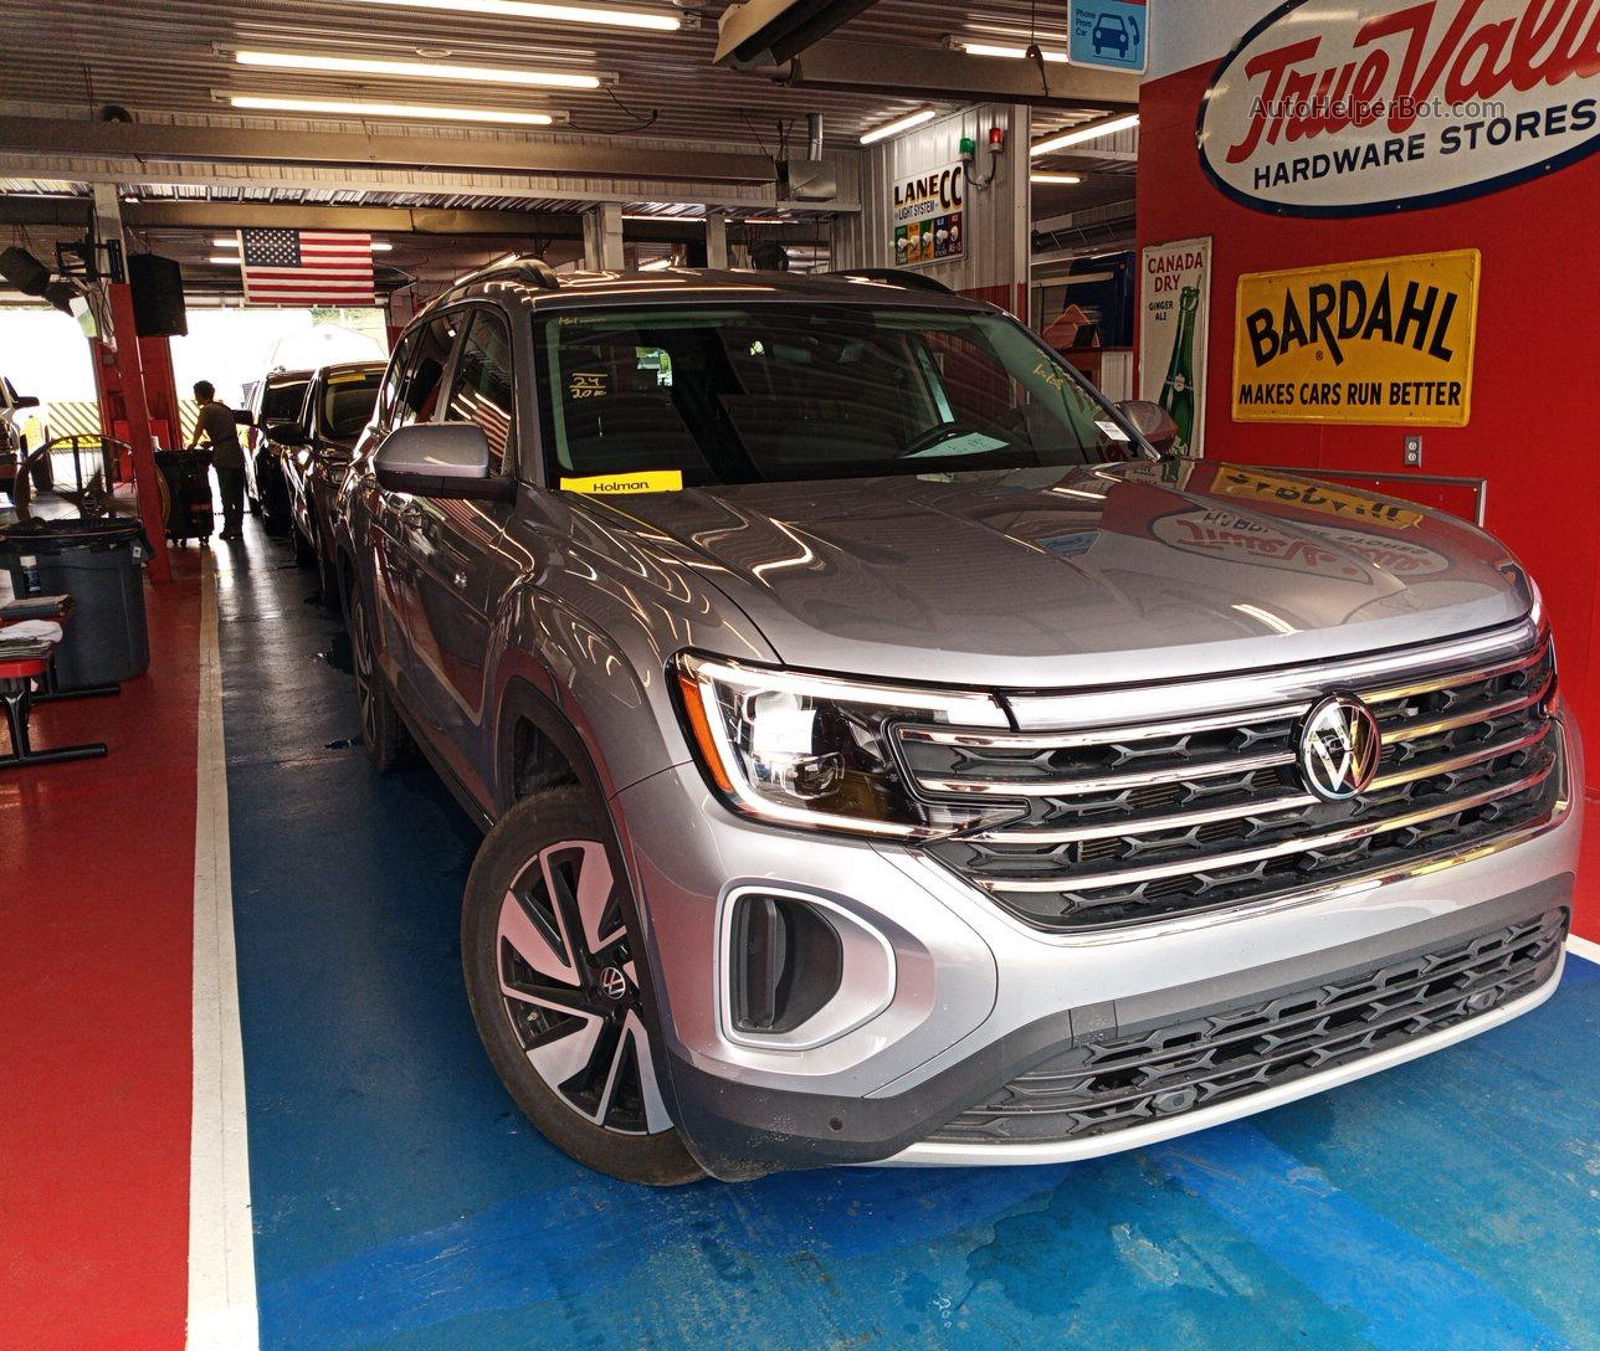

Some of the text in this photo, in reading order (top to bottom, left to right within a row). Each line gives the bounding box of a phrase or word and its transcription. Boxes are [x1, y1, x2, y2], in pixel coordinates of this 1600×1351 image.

[1076, 9, 1097, 19] Phone
[1076, 19, 1092, 28] From
[1076, 28, 1088, 37] Car
[1226, 0, 1600, 164] True Valu
[1254, 99, 1598, 190] HARDWARE STORES
[895, 166, 962, 209] LANE CC
[899, 200, 935, 220] LIGHT SYSTEM
[1148, 252, 1204, 274] CANADA
[1154, 274, 1181, 293] DRY
[1149, 300, 1174, 312] GINGER
[1155, 312, 1168, 321] ALE
[1246, 271, 1458, 369] BARDAHL
[1239, 381, 1462, 406] MAKES CARS RUN BETTER
[593, 482, 650, 492] Holman
